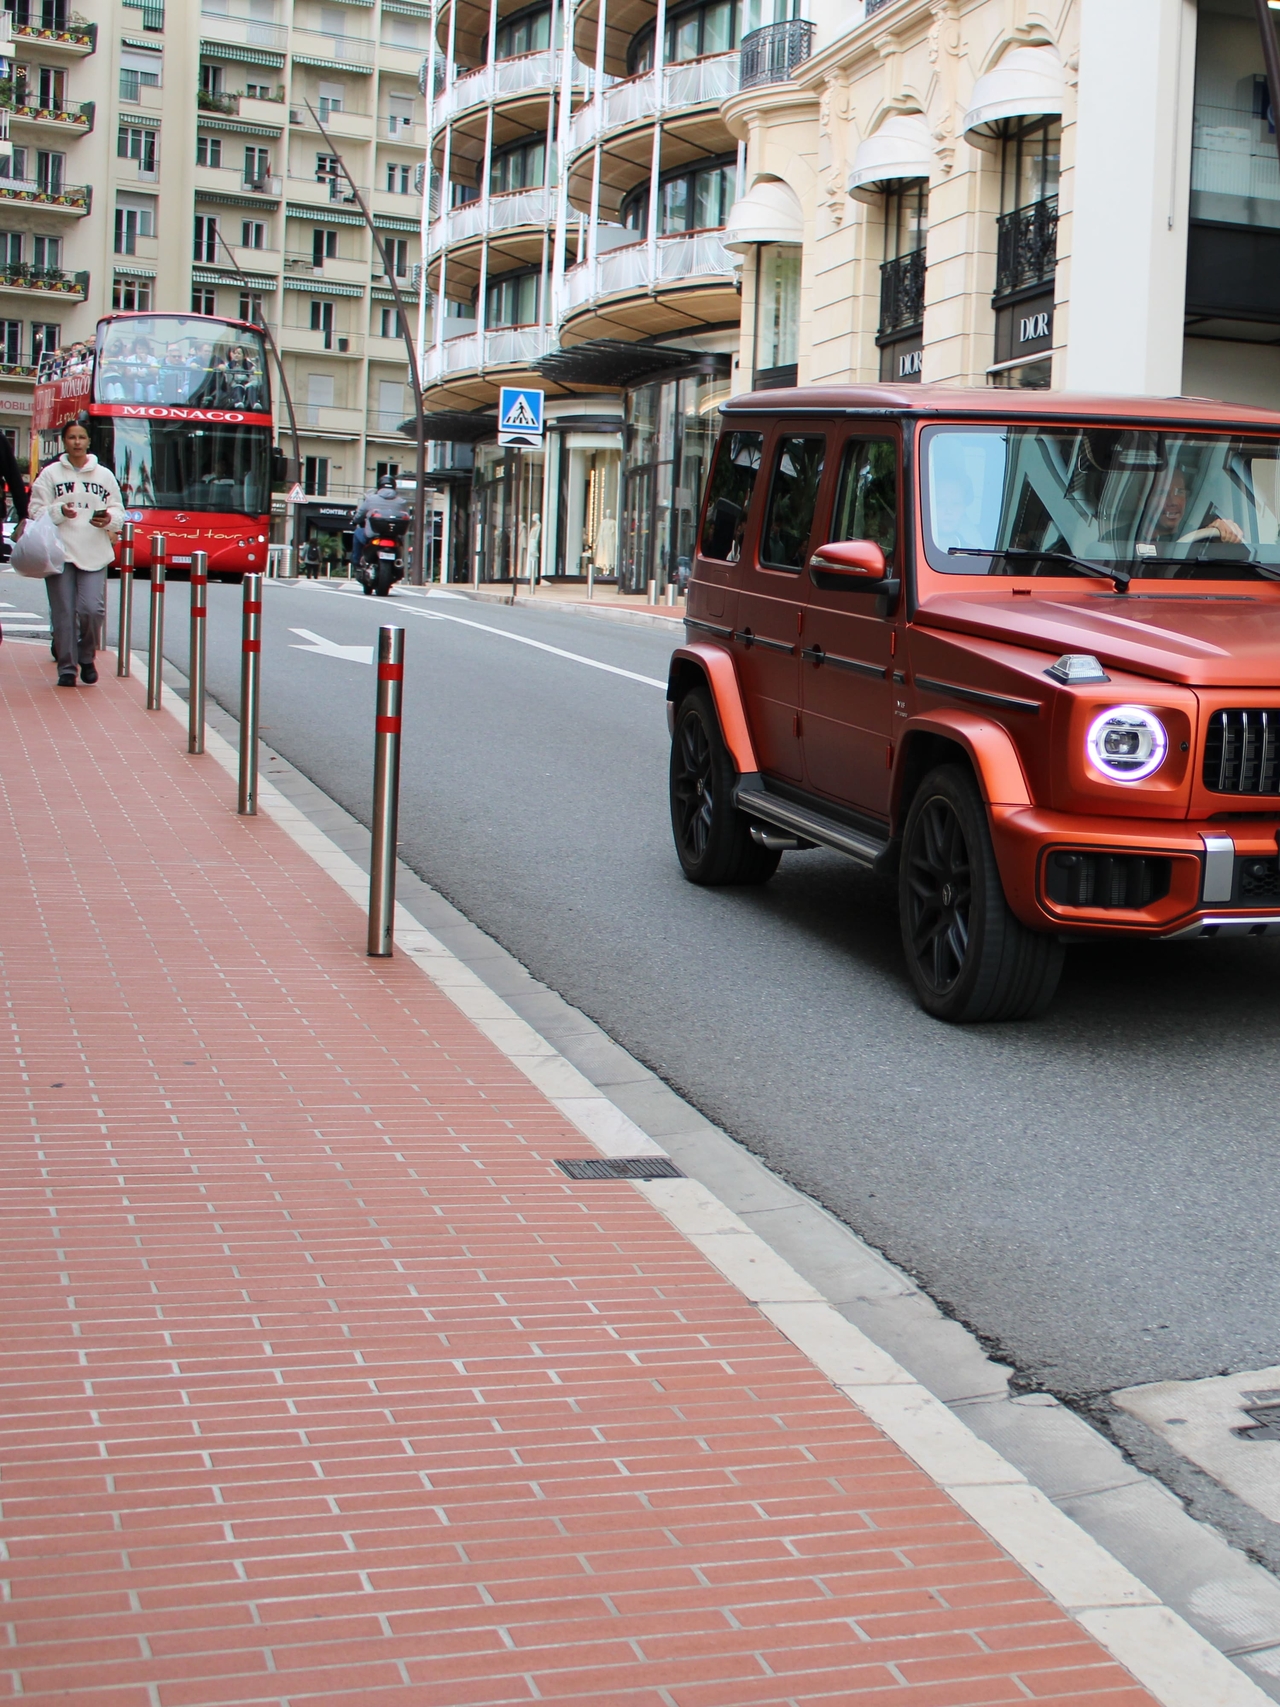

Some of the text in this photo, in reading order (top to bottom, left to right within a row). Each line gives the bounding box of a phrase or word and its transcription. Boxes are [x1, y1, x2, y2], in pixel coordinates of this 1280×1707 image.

[1020, 312, 1049, 343] DIOR
[900, 351, 922, 377] DIOR
[60, 375, 90, 399] MONACO
[122, 405, 244, 422] MONACO
[82, 482, 111, 504] YORK
[147, 528, 200, 540] grand
[204, 529, 243, 540] tour
